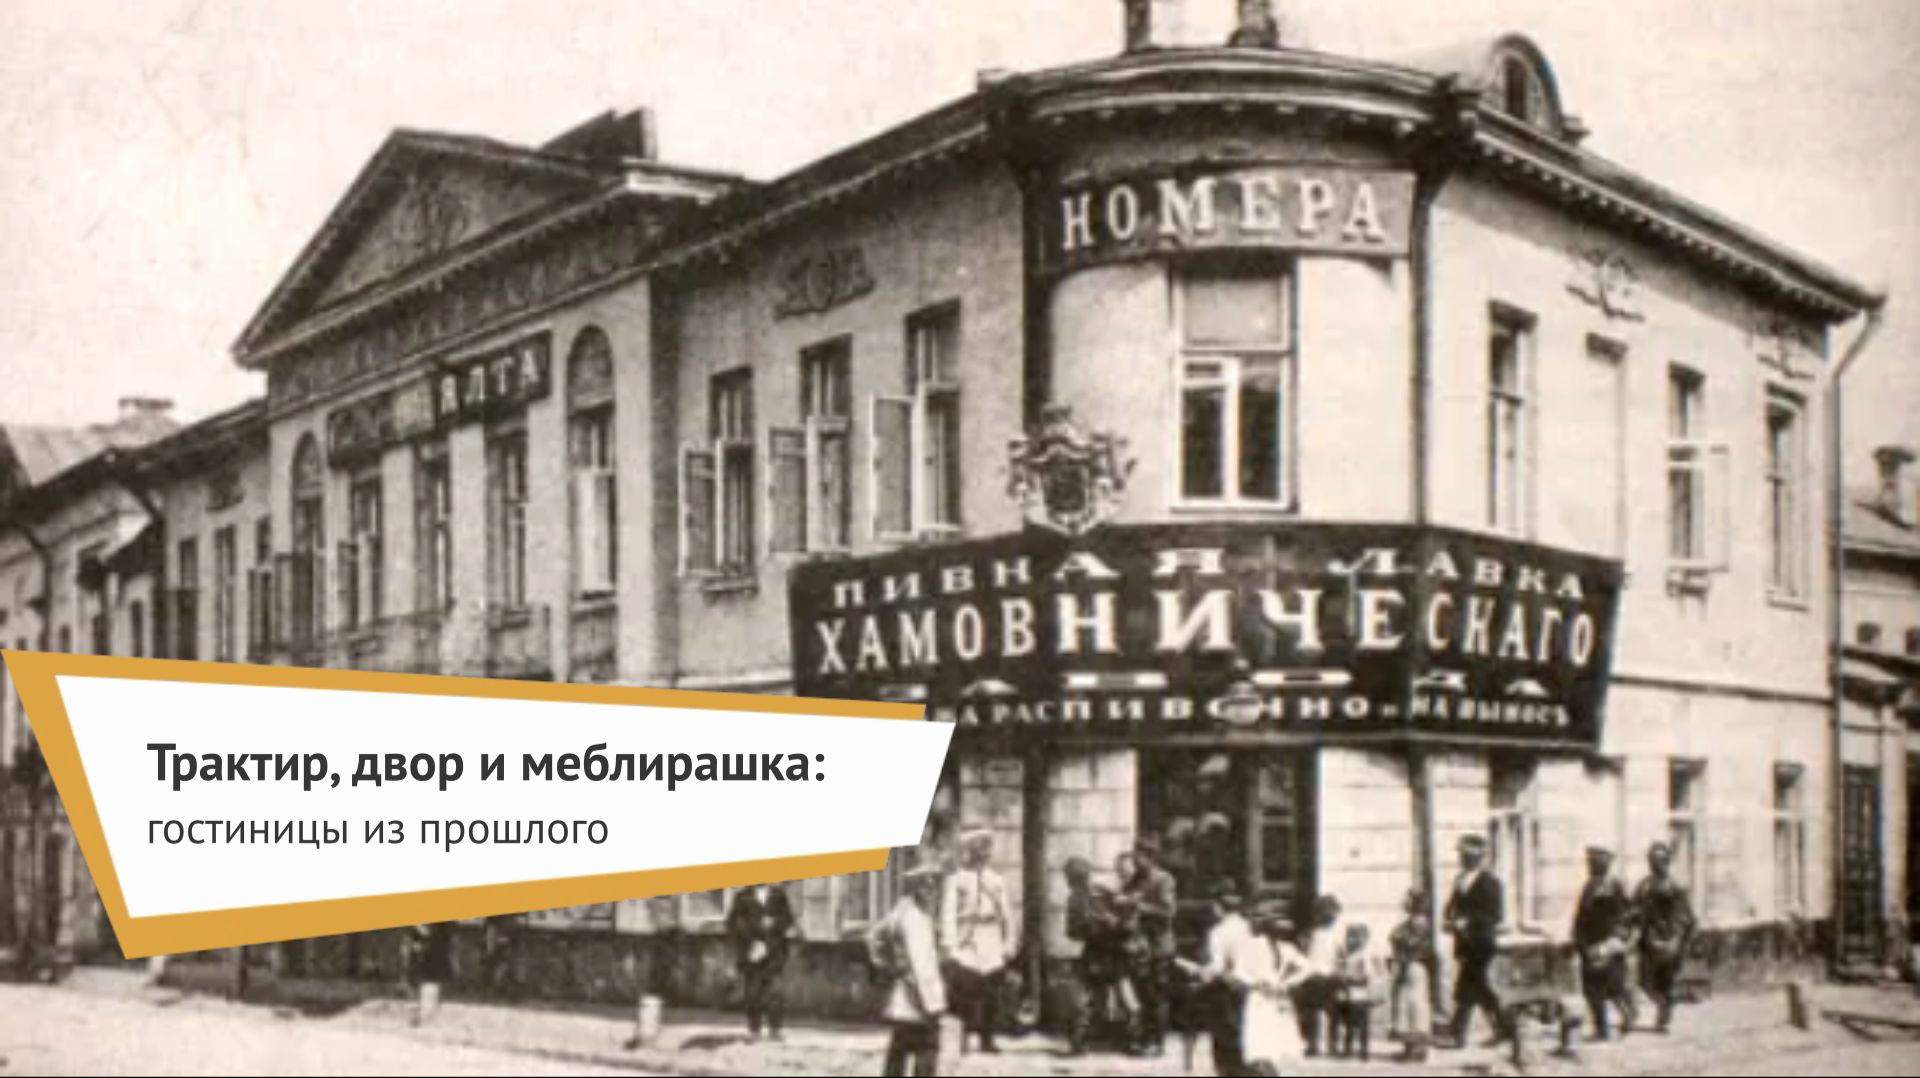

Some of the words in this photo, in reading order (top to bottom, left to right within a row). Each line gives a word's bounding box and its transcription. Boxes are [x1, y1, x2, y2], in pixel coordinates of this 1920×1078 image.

[1061, 175, 1385, 250] НОМЕРА
[440, 349, 540, 416] ЯЛТА
[833, 548, 1225, 608] ПИВНАЯ
[1327, 547, 1584, 599] ЛАВКА
[816, 589, 1594, 675] ХАМОВНИЧЕСКАГО
